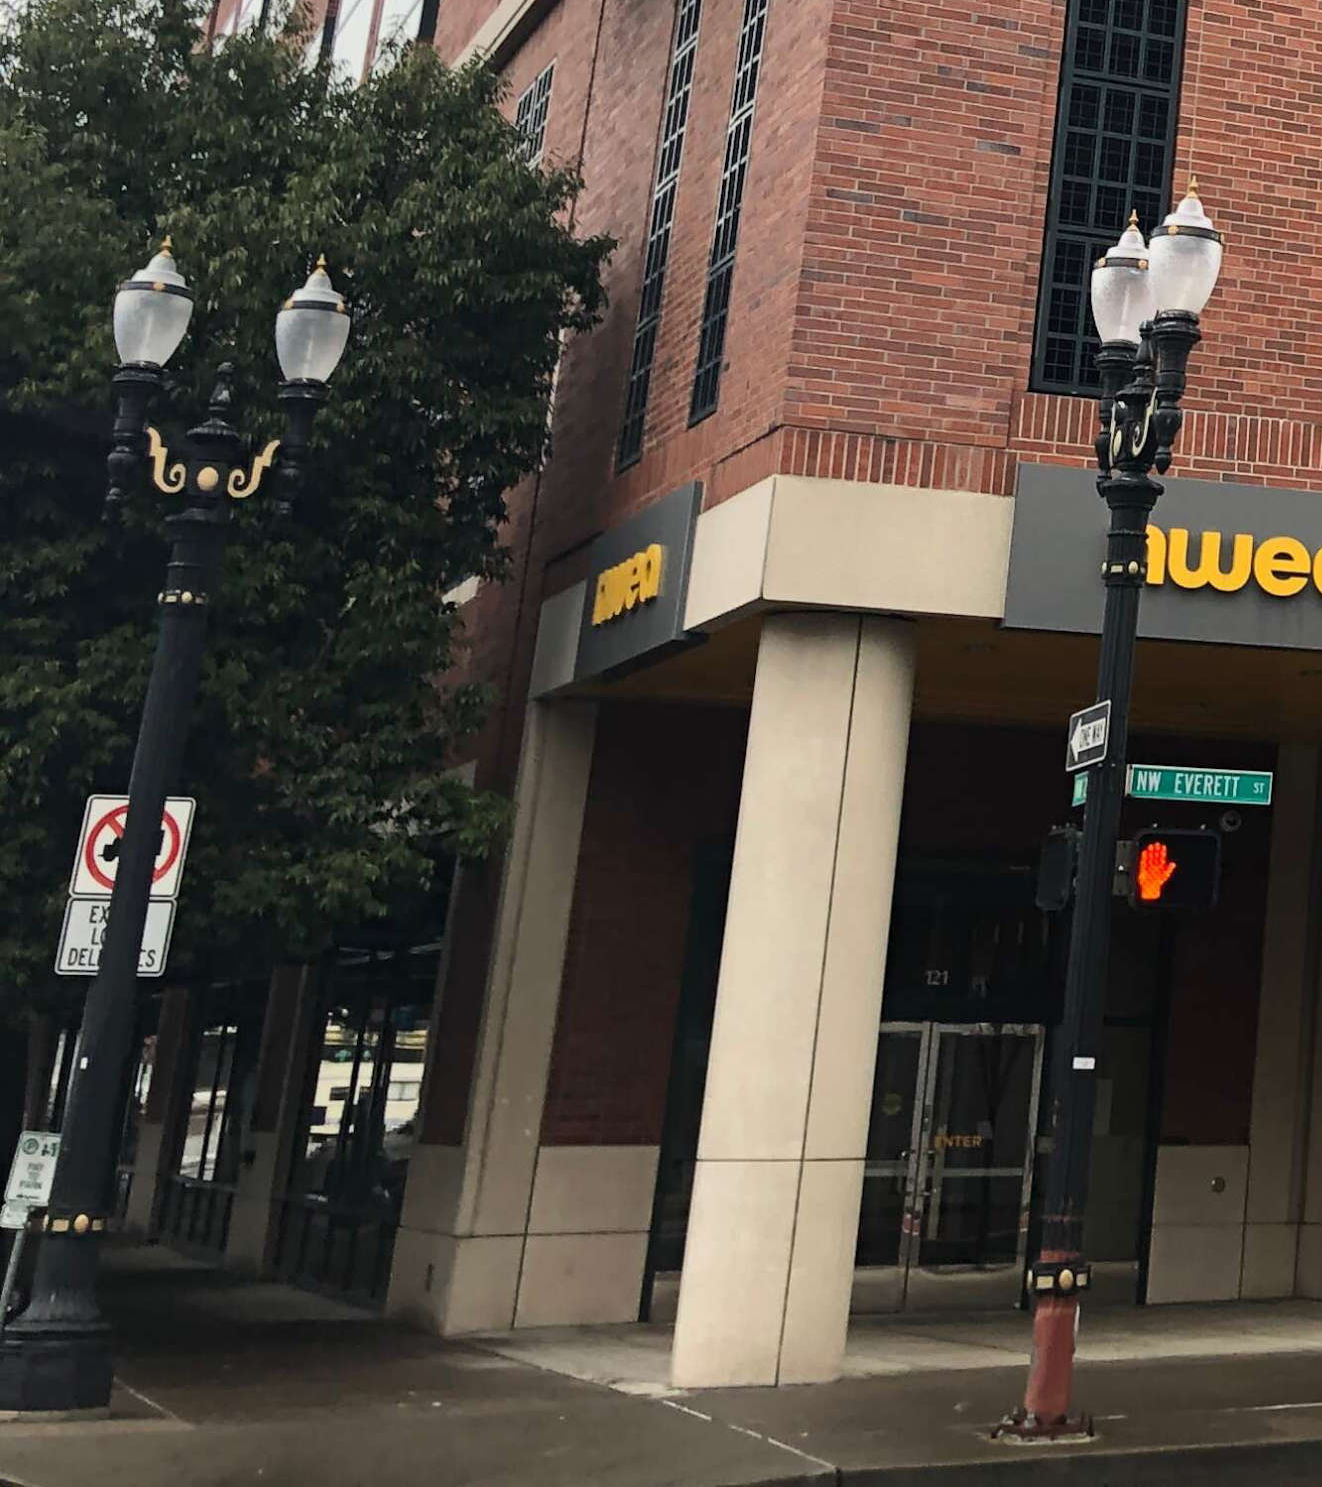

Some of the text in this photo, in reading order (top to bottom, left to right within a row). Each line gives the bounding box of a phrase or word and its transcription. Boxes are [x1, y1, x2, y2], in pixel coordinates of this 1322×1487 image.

[1137, 771, 1265, 797] NW EVERETT ST
